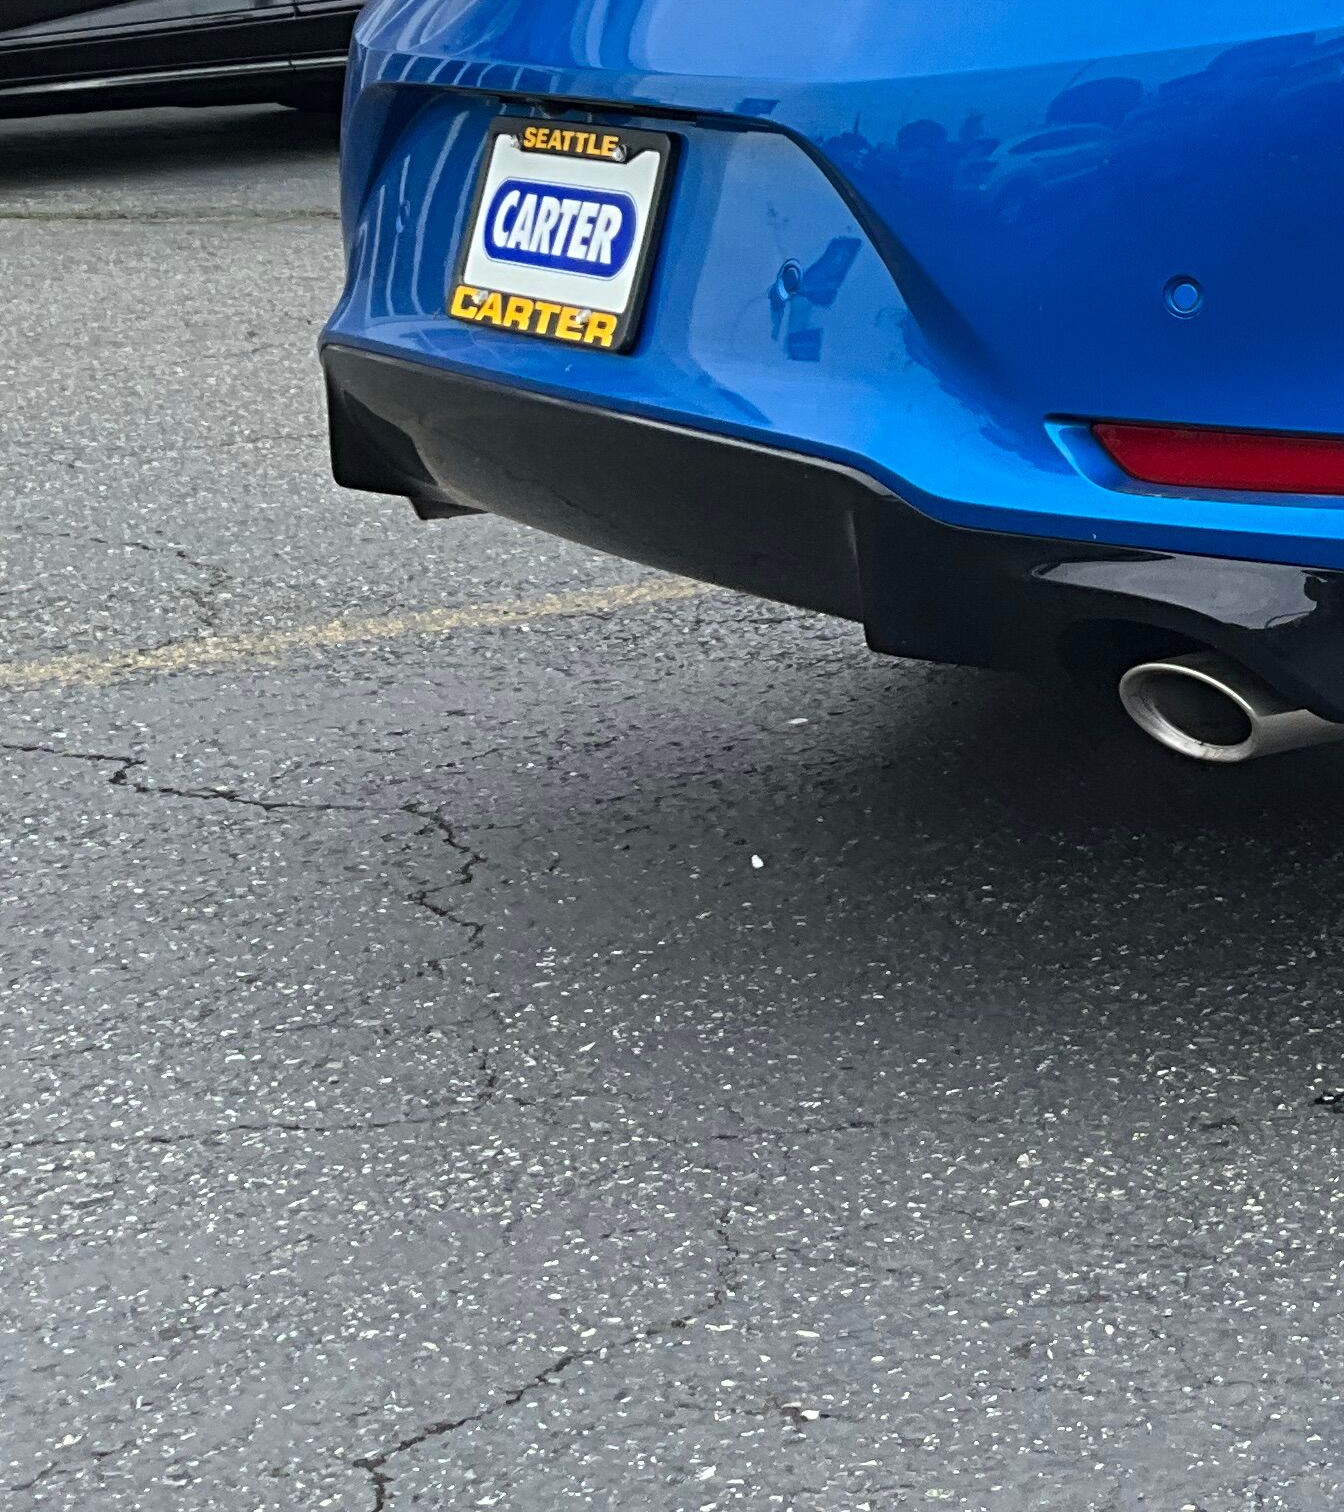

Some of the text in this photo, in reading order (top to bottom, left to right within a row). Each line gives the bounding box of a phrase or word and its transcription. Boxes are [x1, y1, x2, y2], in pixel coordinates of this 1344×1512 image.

[522, 127, 620, 158] SEATTLE
[493, 190, 623, 265] CARTER
[451, 285, 618, 348] CARTER
